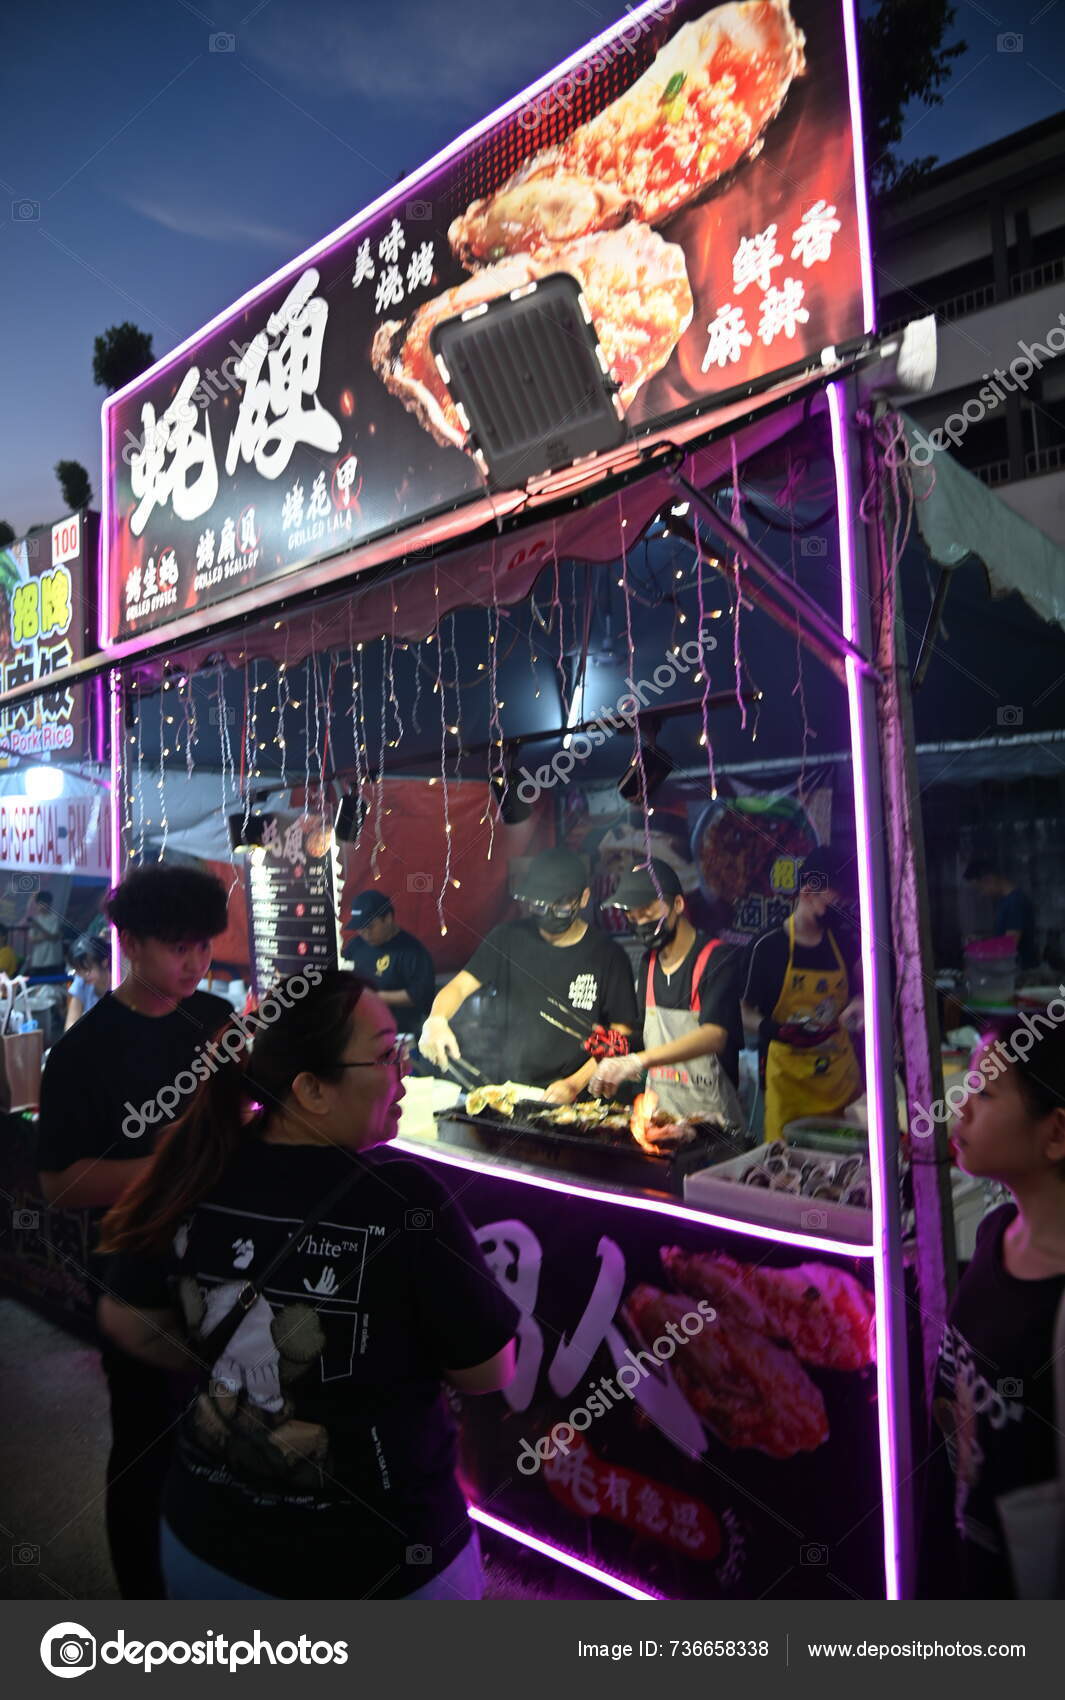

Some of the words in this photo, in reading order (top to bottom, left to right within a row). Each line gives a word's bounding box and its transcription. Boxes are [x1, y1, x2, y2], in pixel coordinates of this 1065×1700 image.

[352, 219, 406, 289] 美味
[375, 241, 435, 315] 烧烤
[732, 199, 842, 295] 鲜香
[701, 277, 810, 374] 麻辣
[130, 267, 342, 536] 蚝硬
[282, 456, 357, 531] 烤花甲
[54, 524, 77, 558] 100
[196, 507, 257, 571] 烤扇贝
[288, 523, 325, 551] GRILLED
[326, 509, 353, 532] LALA
[12, 568, 70, 643] 招牌
[194, 564, 223, 592] GRILLED
[224, 549, 260, 579] SCALLOP
[126, 599, 150, 621] GRILLED
[0, 643, 72, 729] 肉饭
[11, 731, 40, 752] Pork
[43, 726, 72, 747] Rice
[14, 806, 62, 865] SPECIAL
